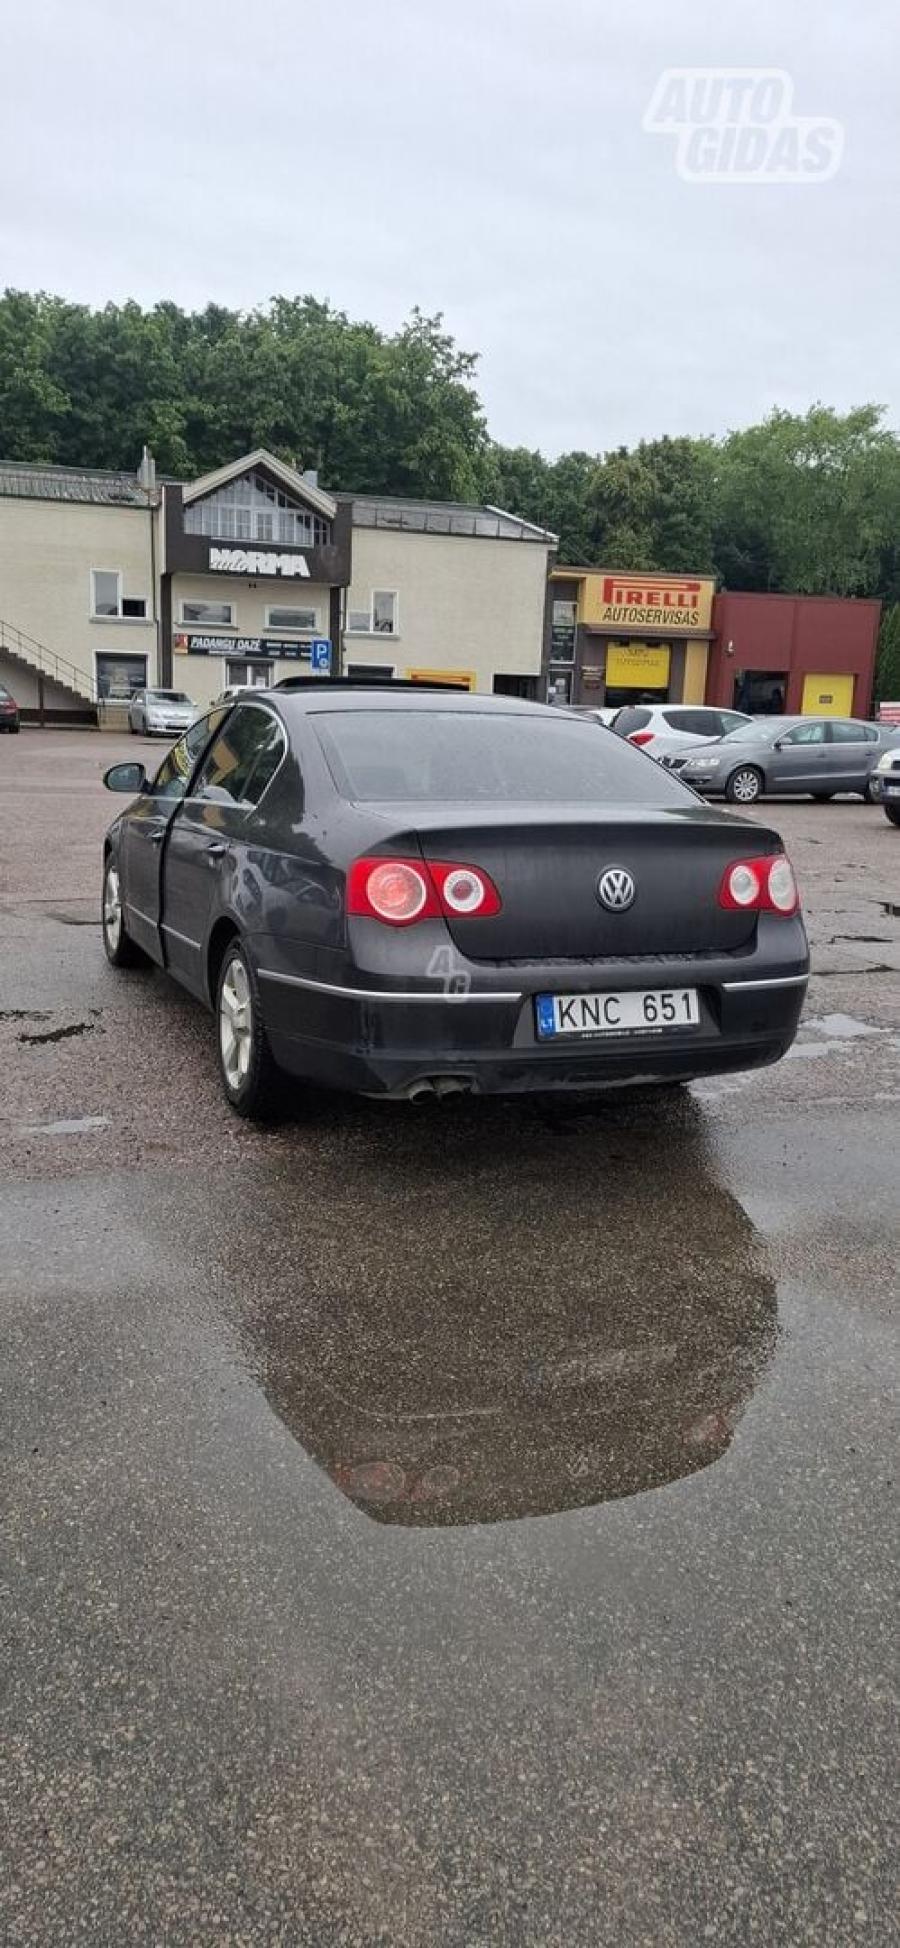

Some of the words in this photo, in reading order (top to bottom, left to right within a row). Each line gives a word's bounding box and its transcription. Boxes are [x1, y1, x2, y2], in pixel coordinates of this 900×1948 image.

[209, 548, 311, 578] NORMA
[603, 578, 701, 608] PIRELLI
[602, 607, 700, 626] AUTOSERVISAS
[316, 644, 327, 659] P
[557, 996, 621, 1030] KNC
[642, 991, 693, 1022] 651
